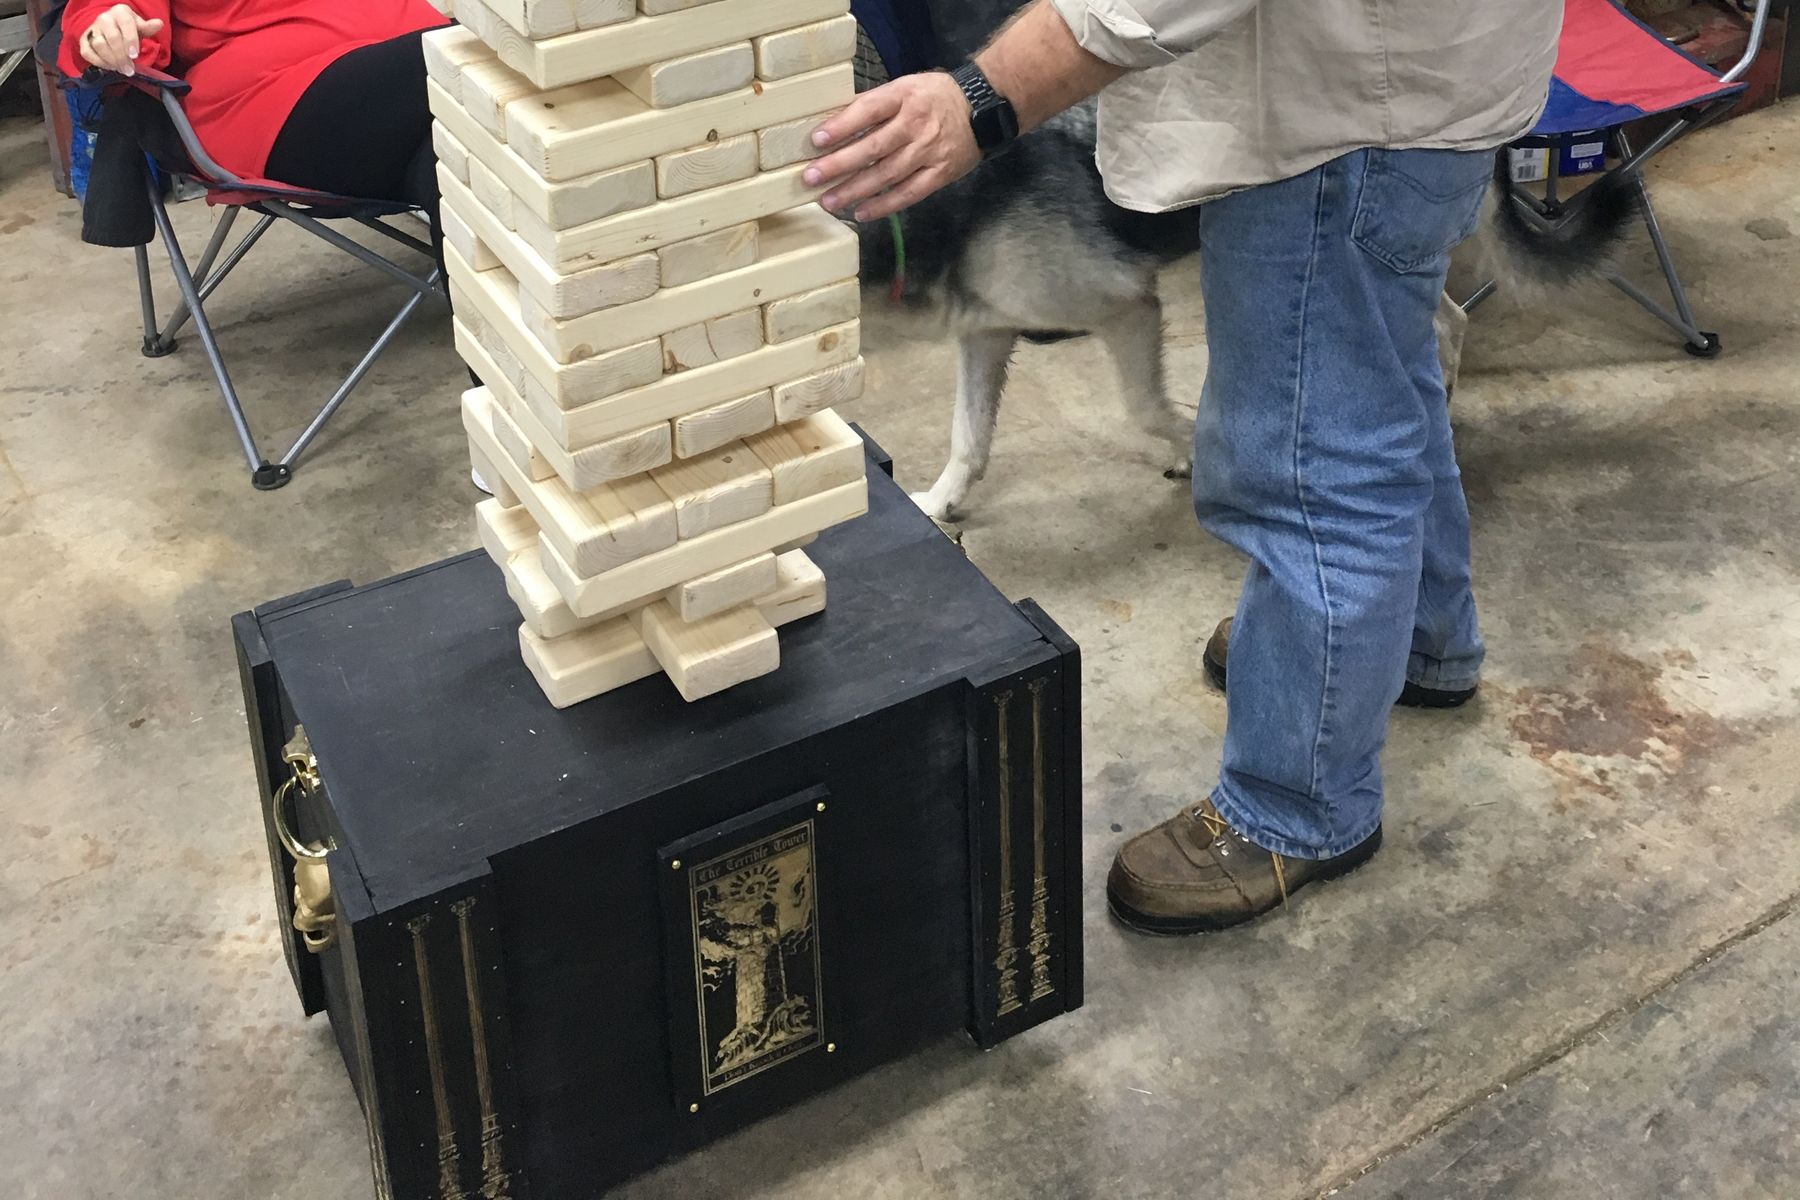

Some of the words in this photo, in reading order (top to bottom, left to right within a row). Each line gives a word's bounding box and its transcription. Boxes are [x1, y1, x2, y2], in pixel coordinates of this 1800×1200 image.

[700, 867, 720, 881] The
[726, 846, 768, 870] Terrible
[773, 832, 806, 851] Tower
